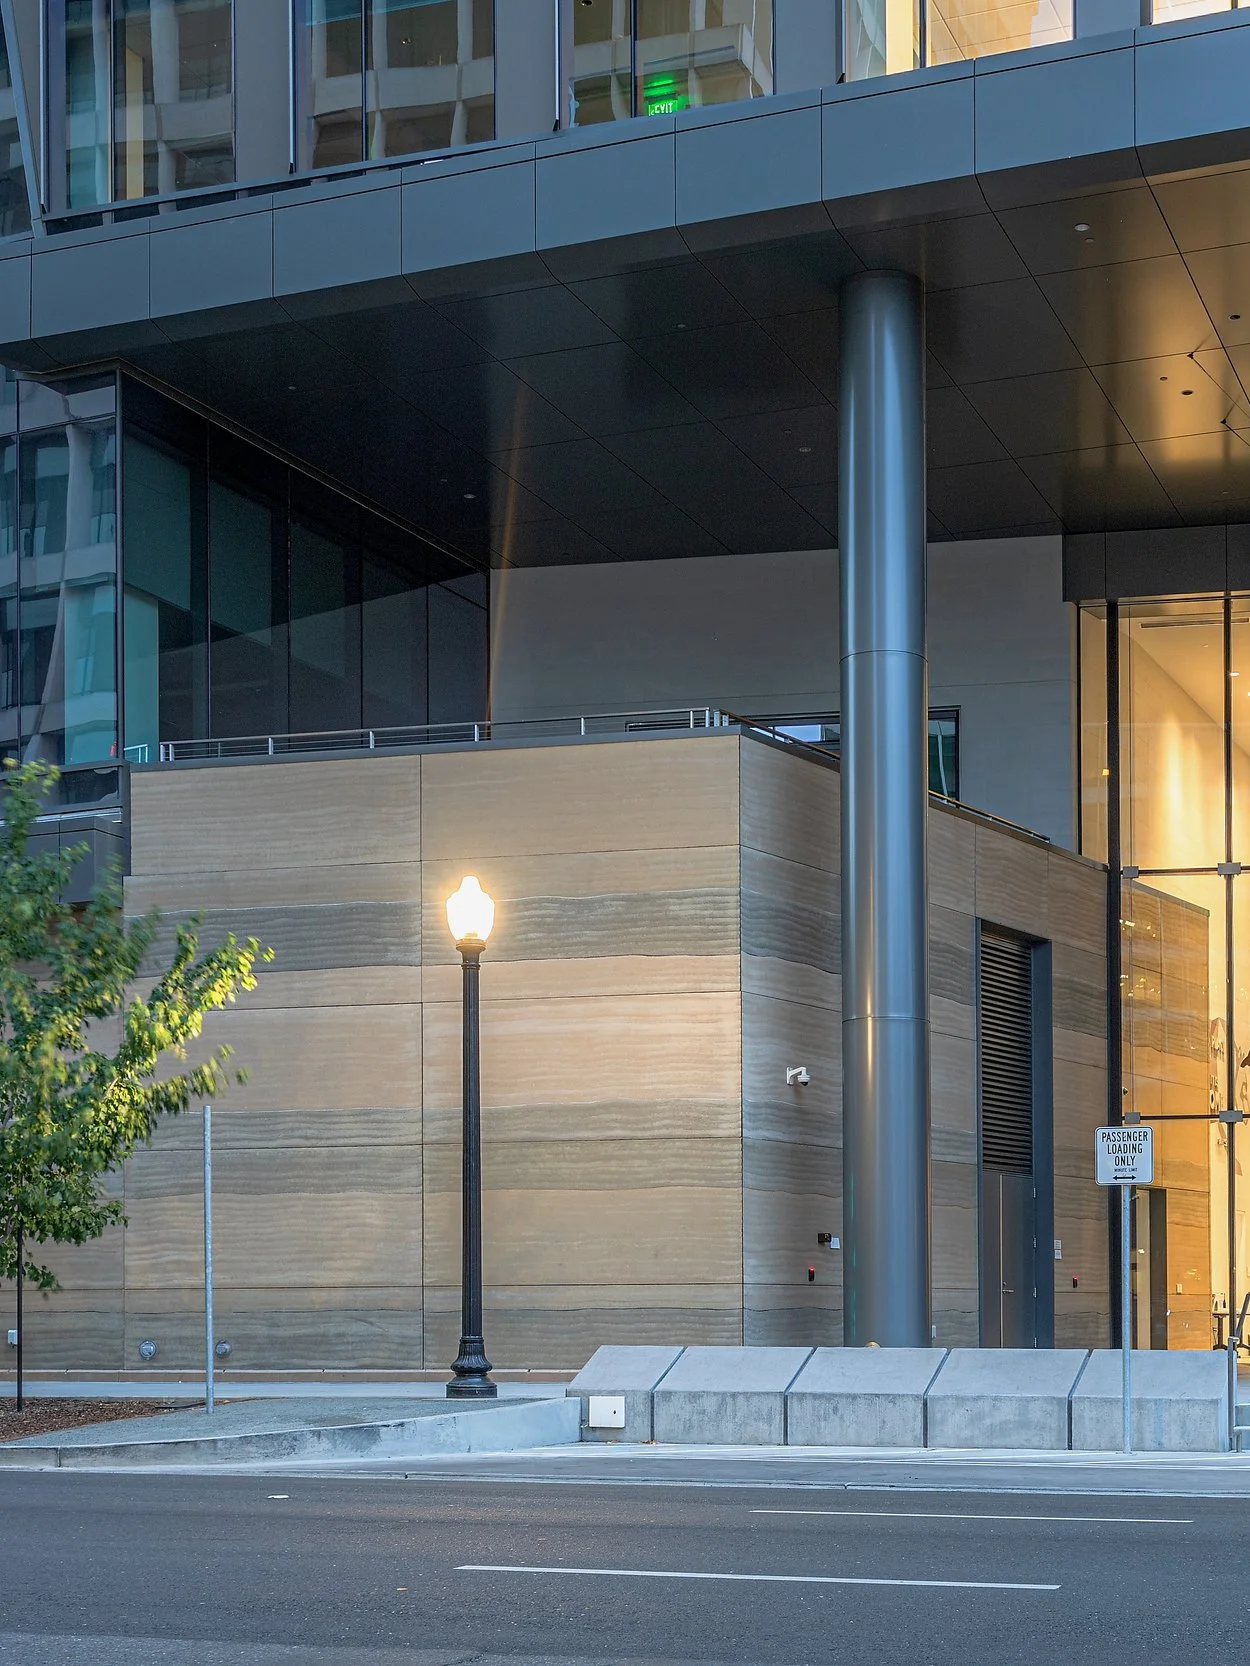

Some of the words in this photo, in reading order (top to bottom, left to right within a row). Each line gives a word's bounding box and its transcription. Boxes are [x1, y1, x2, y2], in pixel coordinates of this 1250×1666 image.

[655, 102, 673, 113] EXIT
[1101, 1131, 1148, 1142] PASSENGER
[1107, 1143, 1143, 1154] LOADING
[1114, 1155, 1136, 1166] ONLY
